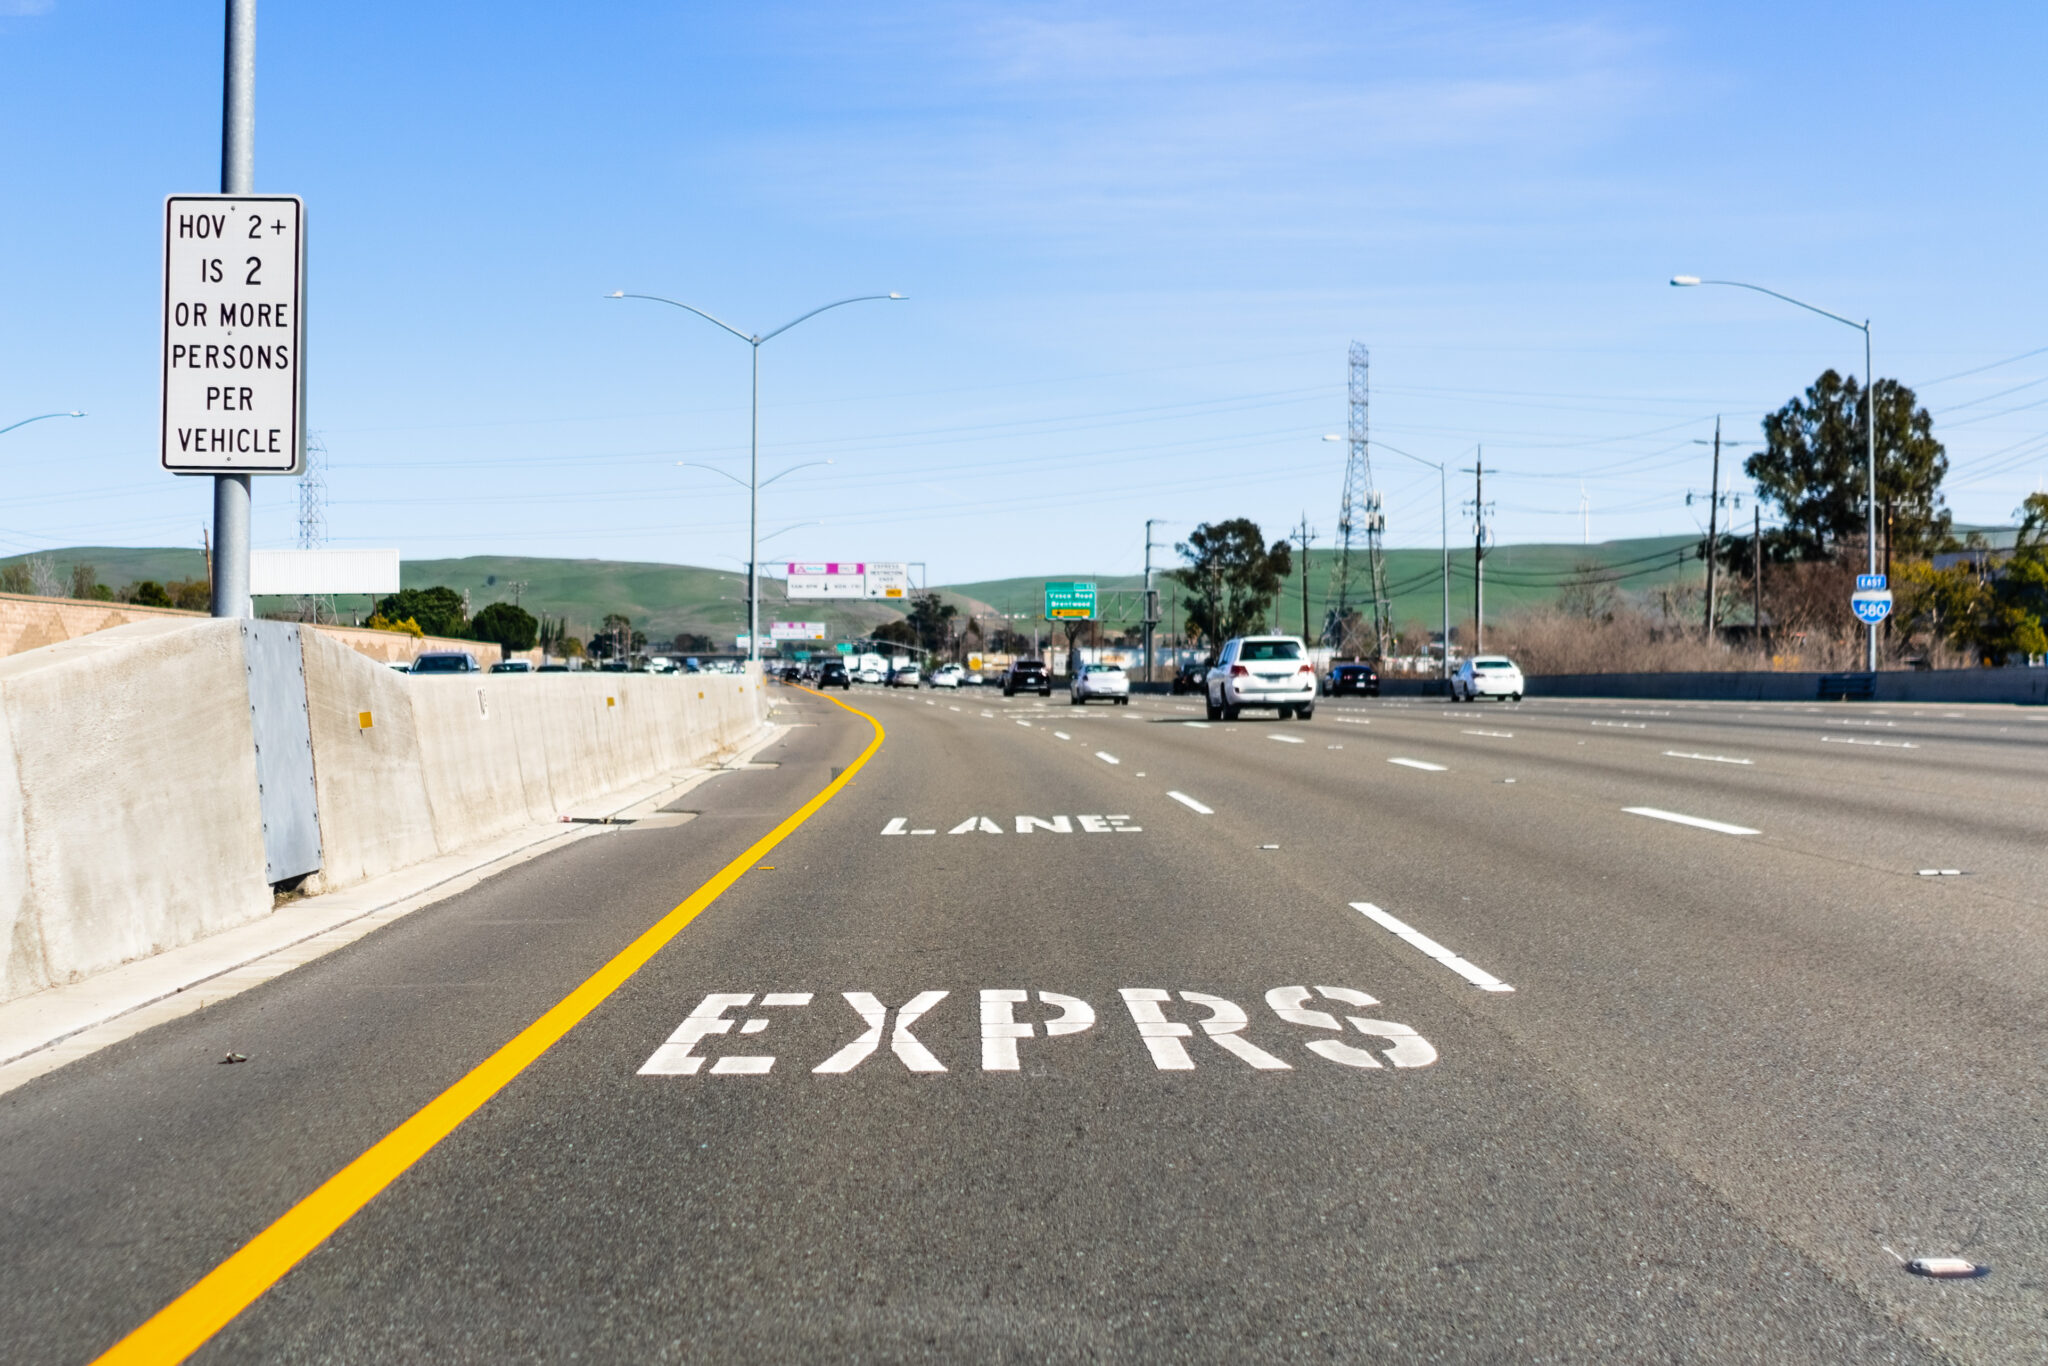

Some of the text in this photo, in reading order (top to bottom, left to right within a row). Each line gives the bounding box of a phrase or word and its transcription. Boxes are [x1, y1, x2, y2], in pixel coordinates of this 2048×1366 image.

[179, 214, 287, 239] HOV 2+
[202, 256, 262, 286] IS 2
[175, 302, 288, 327] OR MORE
[172, 344, 289, 369] PERSONS
[206, 387, 253, 410] PER
[178, 428, 281, 453] VEHICLE
[1861, 578, 1882, 587] EAST
[1859, 603, 1886, 617] 580
[880, 814, 1143, 835] LANE
[635, 984, 1440, 1076] EXPRS
